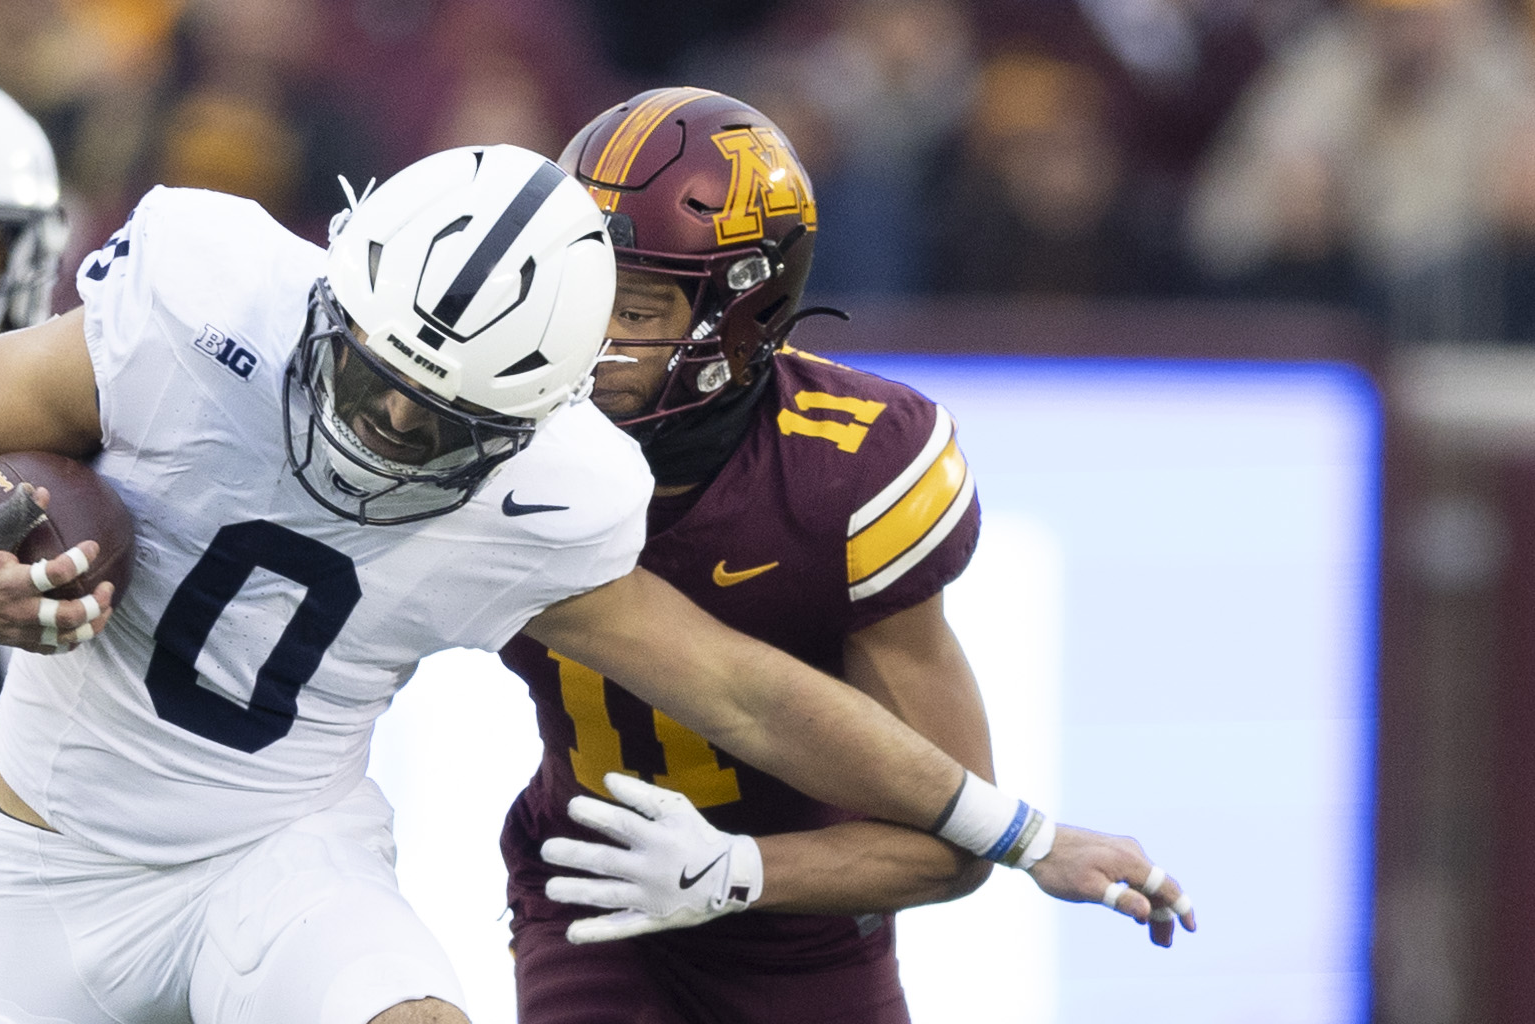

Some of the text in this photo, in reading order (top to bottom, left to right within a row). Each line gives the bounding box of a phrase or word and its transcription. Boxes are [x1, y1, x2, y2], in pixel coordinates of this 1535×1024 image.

[387, 333, 448, 379] PENN STATE
[777, 390, 887, 454] 11
[145, 518, 363, 753] 0
[547, 648, 742, 809] 11
